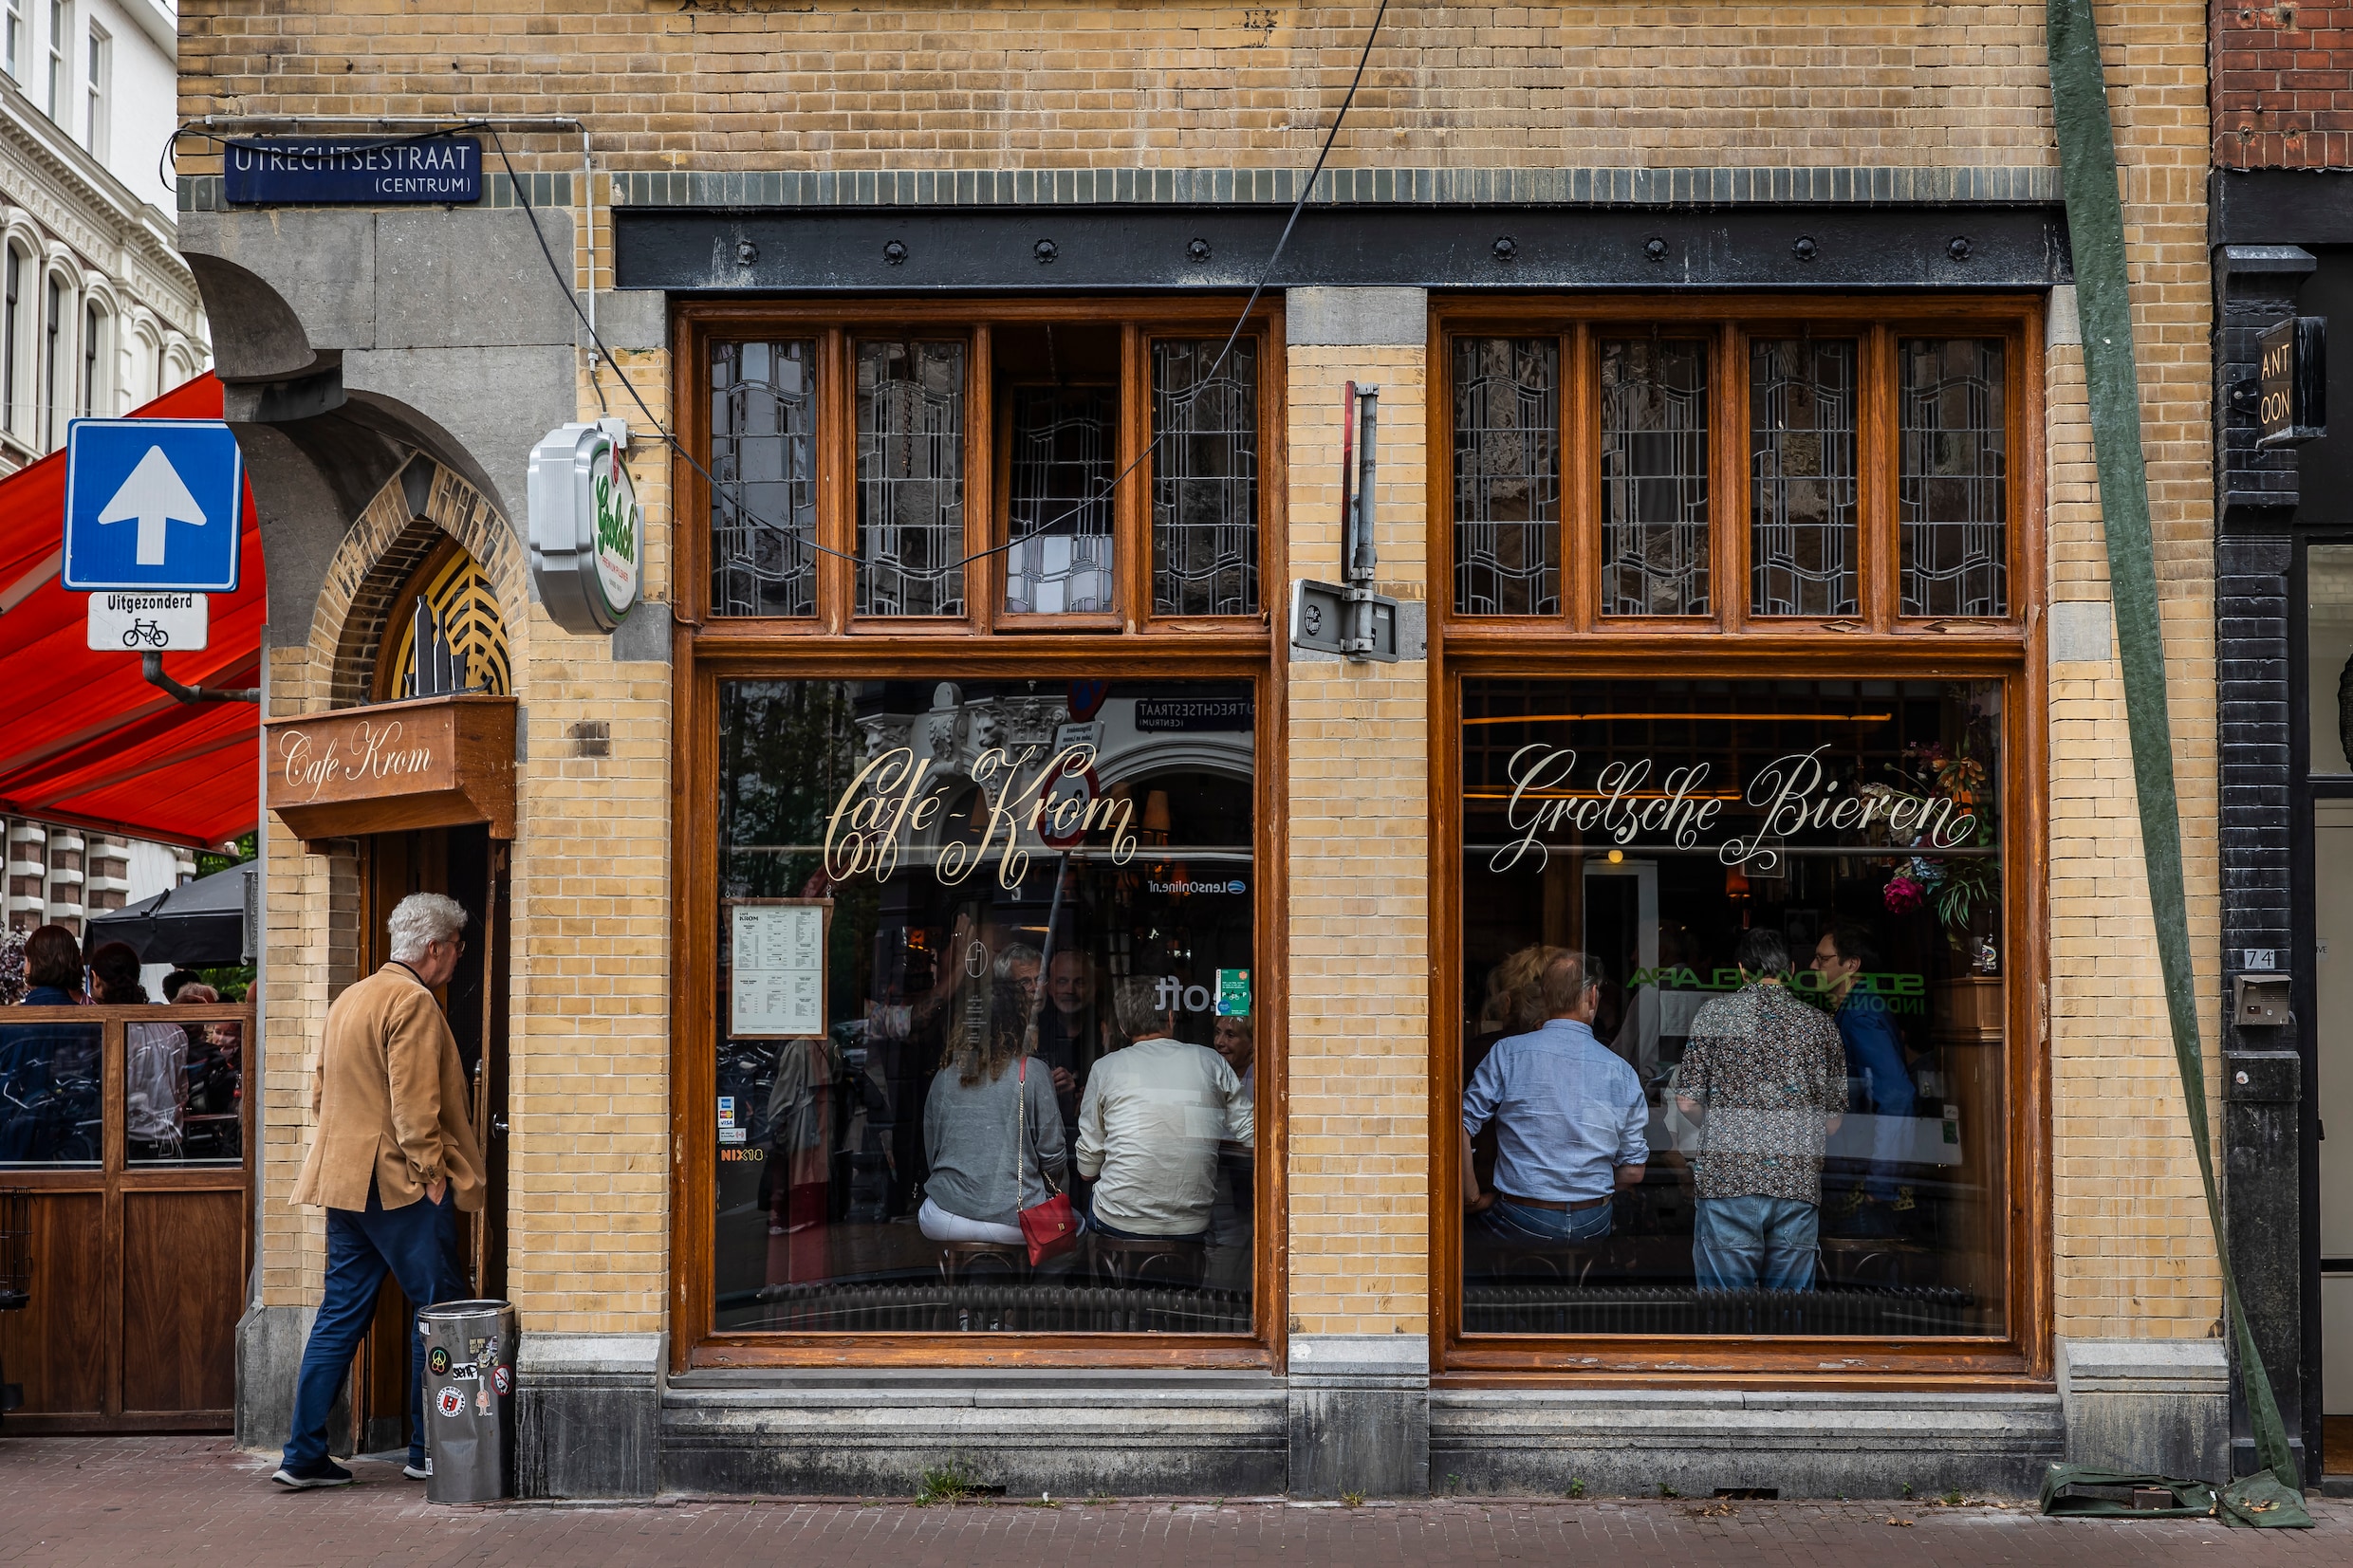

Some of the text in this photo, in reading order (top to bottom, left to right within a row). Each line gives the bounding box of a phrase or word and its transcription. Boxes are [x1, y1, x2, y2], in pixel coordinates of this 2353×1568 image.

[235, 146, 471, 171] UTRECHTSESTRAAT
[375, 176, 471, 193] (CENTRUM)
[2262, 343, 2289, 380] ANT
[2261, 388, 2289, 424] OON
[596, 474, 635, 565] Grolsch
[108, 593, 193, 614] Uitgezonderd
[279, 721, 434, 802] Cafe Krom
[936, 743, 1137, 890] Krom
[1490, 743, 1977, 874] Grolsche Bieren
[721, 1149, 764, 1161] NIX18
